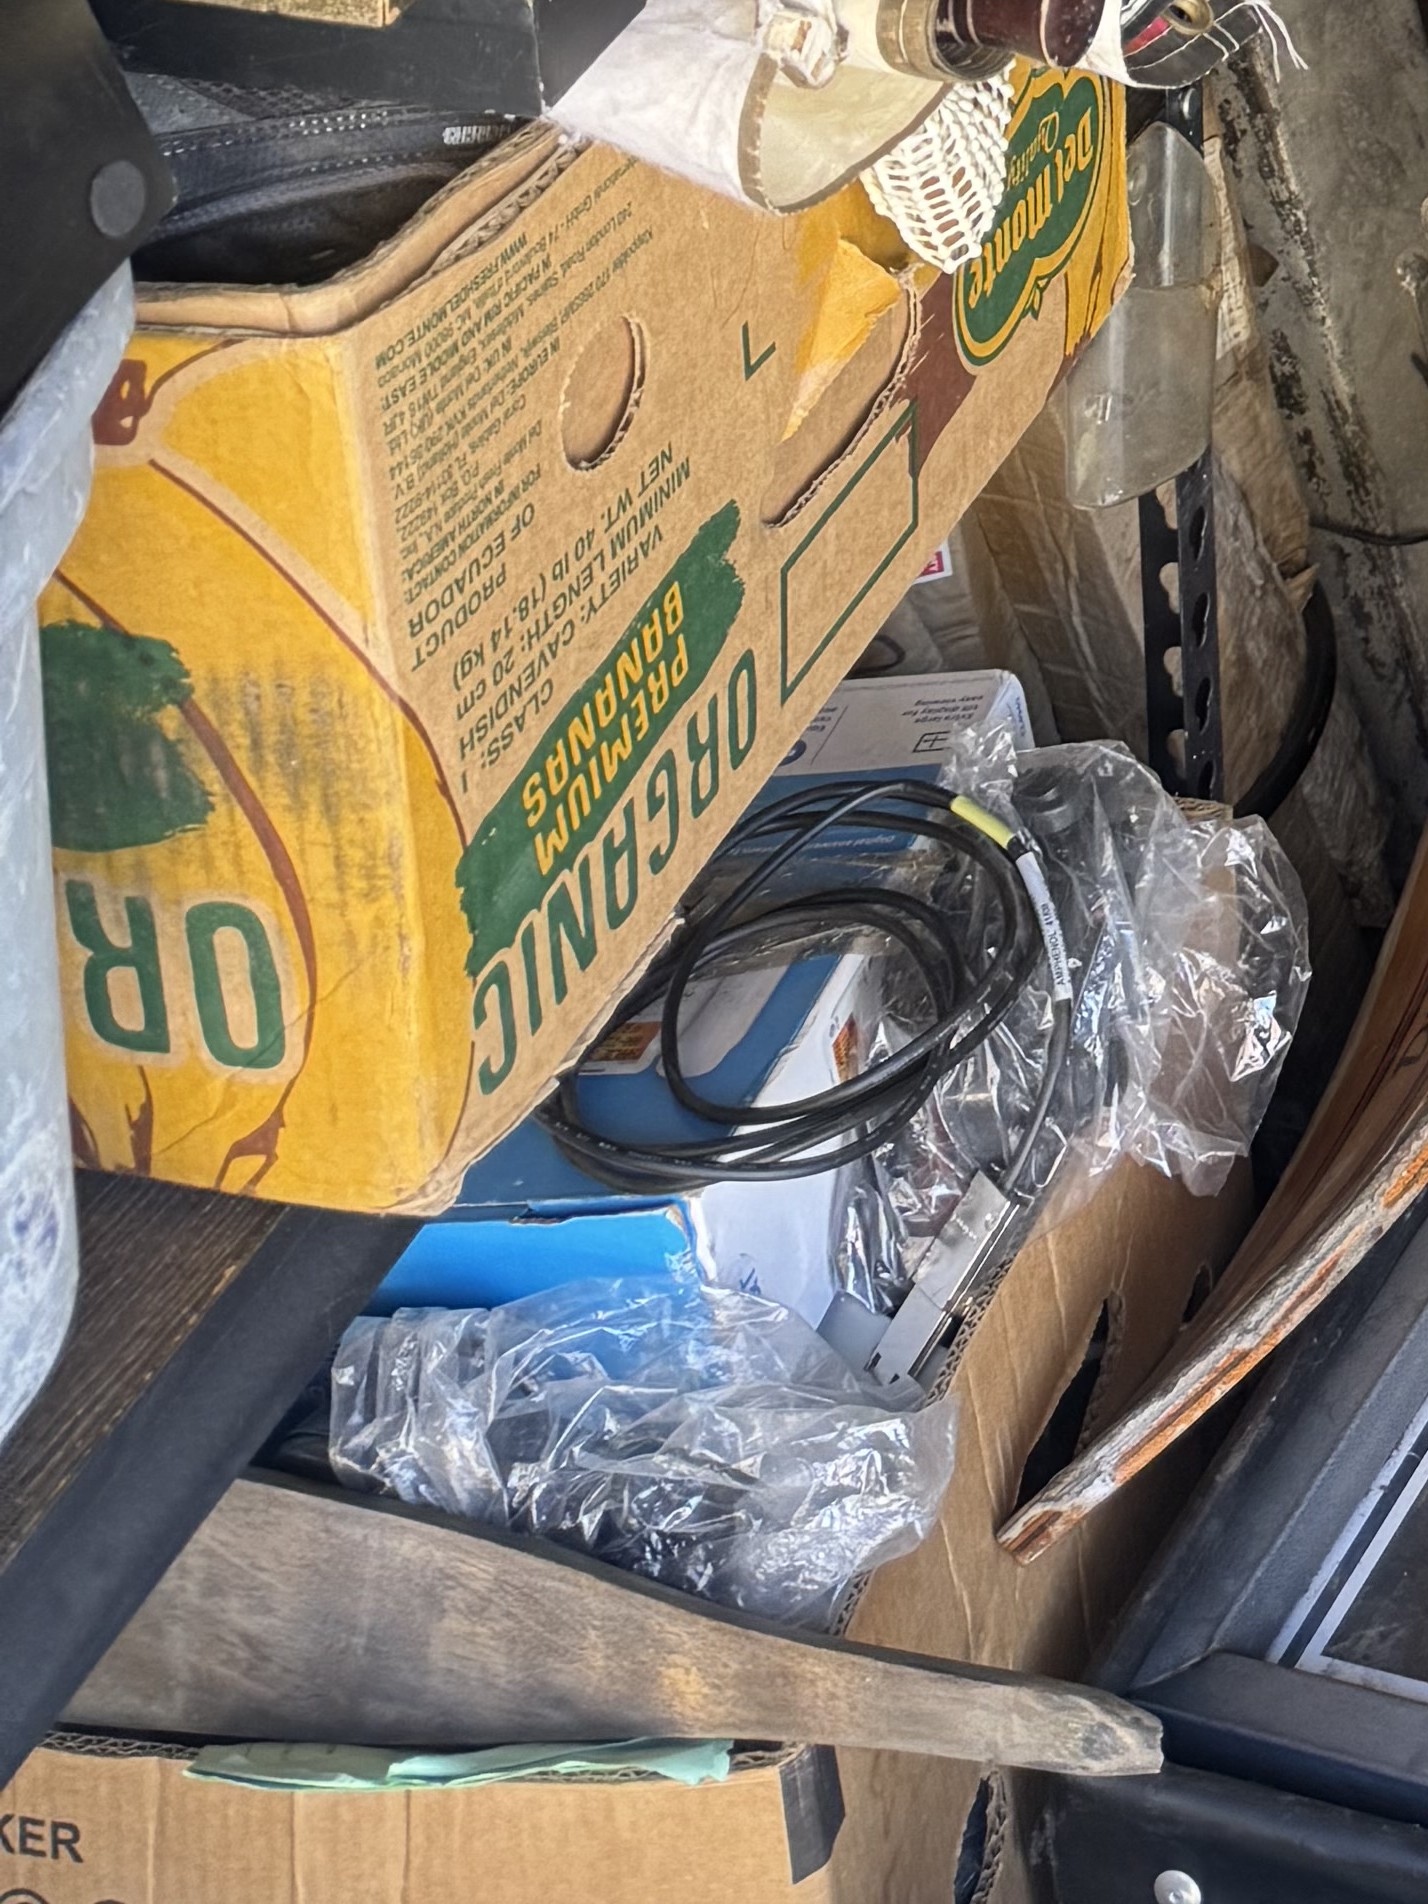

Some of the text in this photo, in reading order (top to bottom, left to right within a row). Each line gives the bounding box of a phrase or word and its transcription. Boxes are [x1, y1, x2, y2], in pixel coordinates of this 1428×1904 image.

[968, 106, 1094, 310] Del Monte
[1005, 110, 1060, 192] Quality
[460, 317, 482, 347] AND
[403, 462, 541, 611] FOR INFORMATION CONTACT:
[407, 499, 535, 646] OF ECUADOR
[451, 439, 673, 697] NET WT. 40 lb (18.14 kg)
[457, 489, 492, 534] NORTH
[409, 557, 506, 678] PRODUCT
[455, 452, 690, 725] MINIMUM LENGTH: 20 cm
[457, 517, 662, 767] VARIETY: CAVENDISH
[479, 670, 555, 779] CLASS:
[517, 574, 687, 836] BANANAS
[529, 628, 691, 884] PREMIUM
[466, 627, 764, 1127] ORGANIC
[1046, 929, 1066, 986] AMPHENOL
